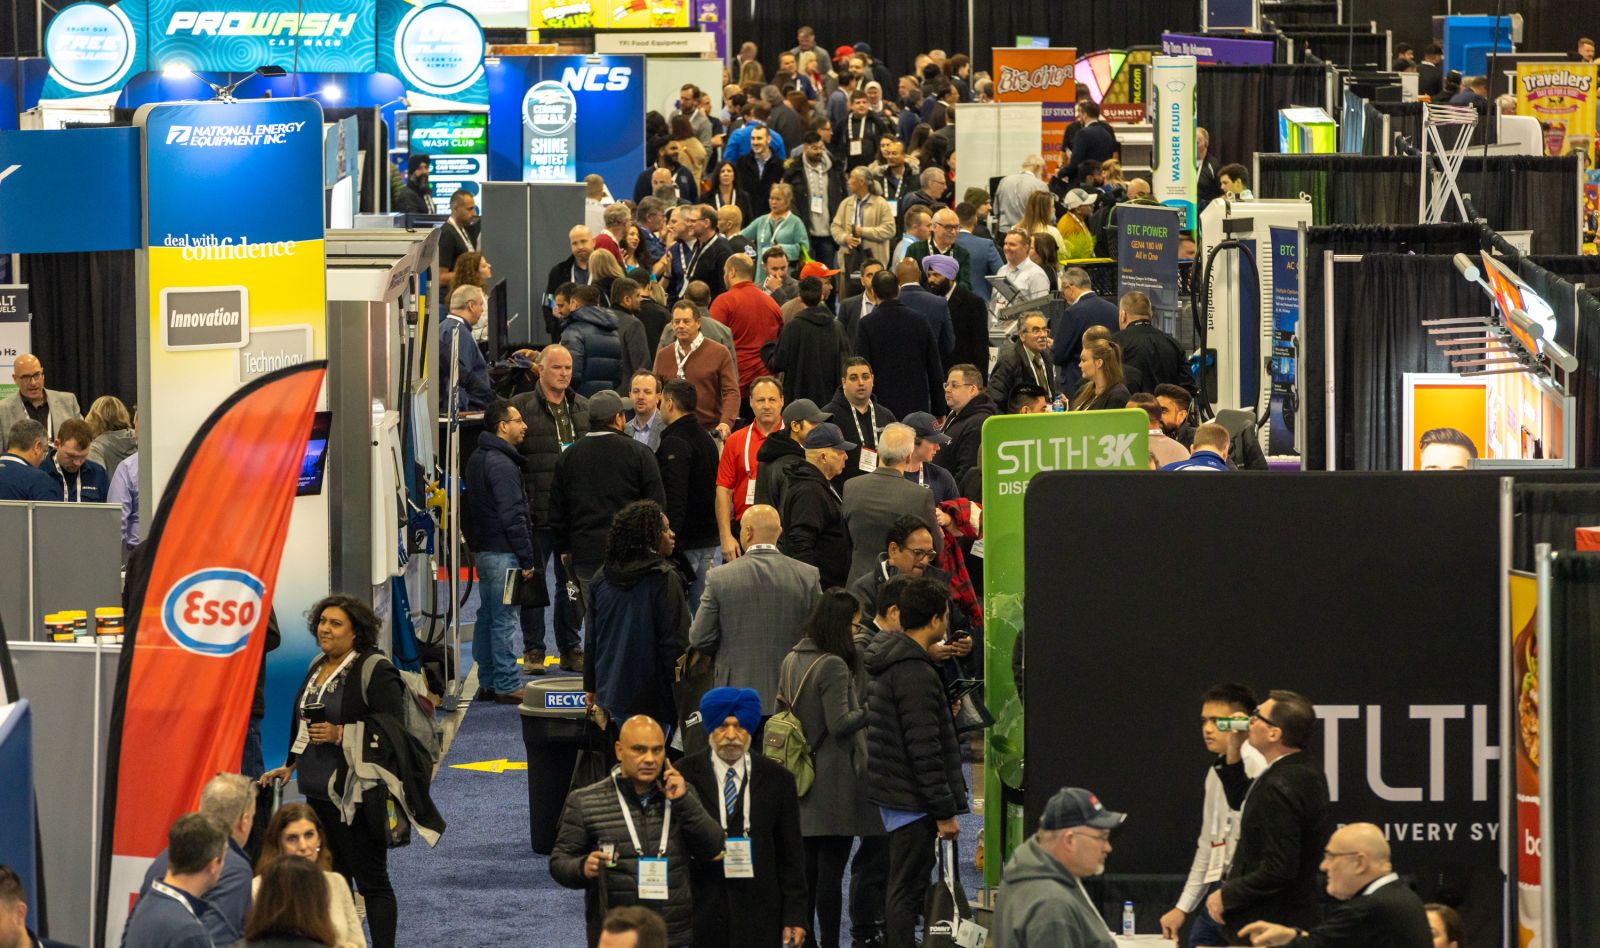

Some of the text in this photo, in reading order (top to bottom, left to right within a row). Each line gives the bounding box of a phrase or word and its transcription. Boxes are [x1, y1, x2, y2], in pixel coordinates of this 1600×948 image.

[166, 12, 357, 36] PROWASH
[651, 40, 688, 48] Equipment
[560, 66, 632, 91] NCS
[1522, 70, 1592, 92] Travellers
[1103, 109, 1143, 117] SUMMIT
[192, 121, 305, 137] NATIONAL ENERGY
[190, 134, 287, 147] EQUIPMENT INC.
[422, 139, 475, 147] WASH CLUB
[531, 137, 568, 154] SHINE
[1172, 102, 1180, 181] WASHER FLUID
[530, 153, 568, 166] PROTECT
[538, 166, 569, 179] SEAL
[1127, 224, 1168, 238] BTC POWER
[164, 233, 219, 246] deal with
[182, 236, 297, 261] confidence
[1280, 245, 1295, 256] BTC
[1286, 262, 1295, 270] AC
[0, 295, 16, 306] LT
[170, 307, 239, 328] Innovation
[1096, 433, 1138, 468] 3K
[184, 590, 255, 627] Esso
